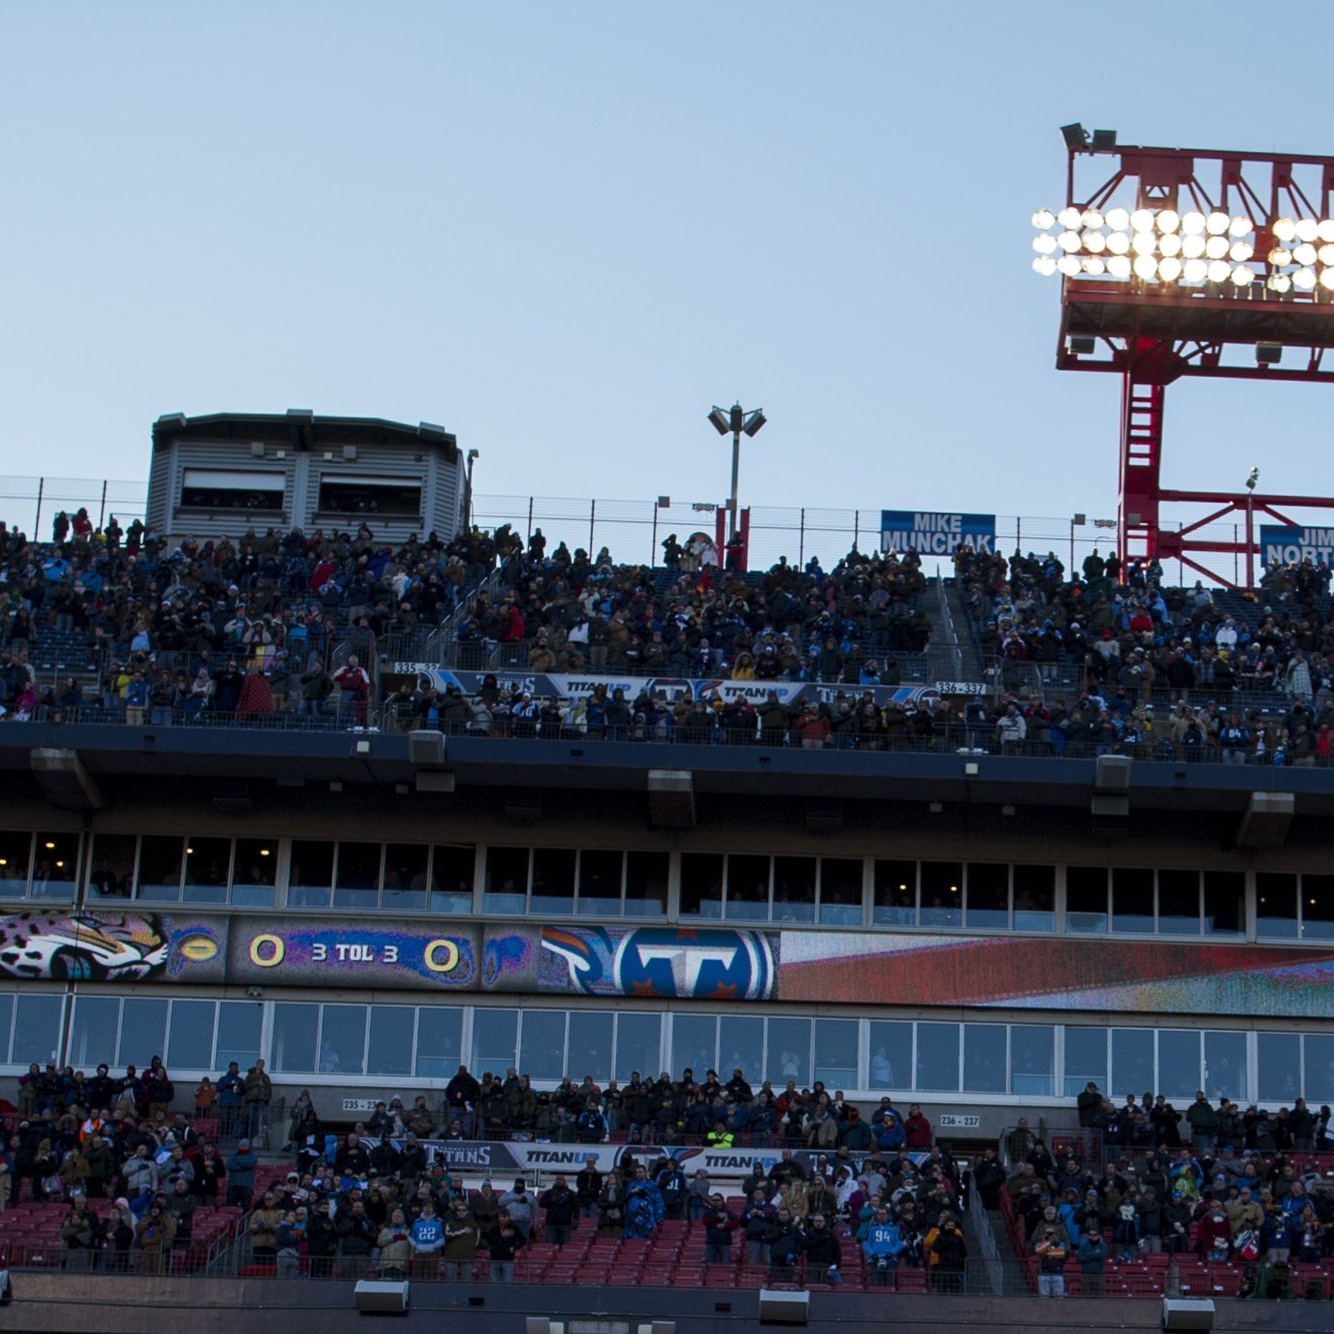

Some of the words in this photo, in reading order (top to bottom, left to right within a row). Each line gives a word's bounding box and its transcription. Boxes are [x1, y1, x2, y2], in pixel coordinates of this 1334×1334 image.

[914, 513, 962, 533] MIKE
[882, 530, 991, 554] MUNCHAK
[1298, 528, 1334, 546] JIM
[336, 944, 374, 961] TOL
[423, 1144, 491, 1166] TTANS
[418, 1227, 436, 1241] 22
[875, 1229, 891, 1243] 94
